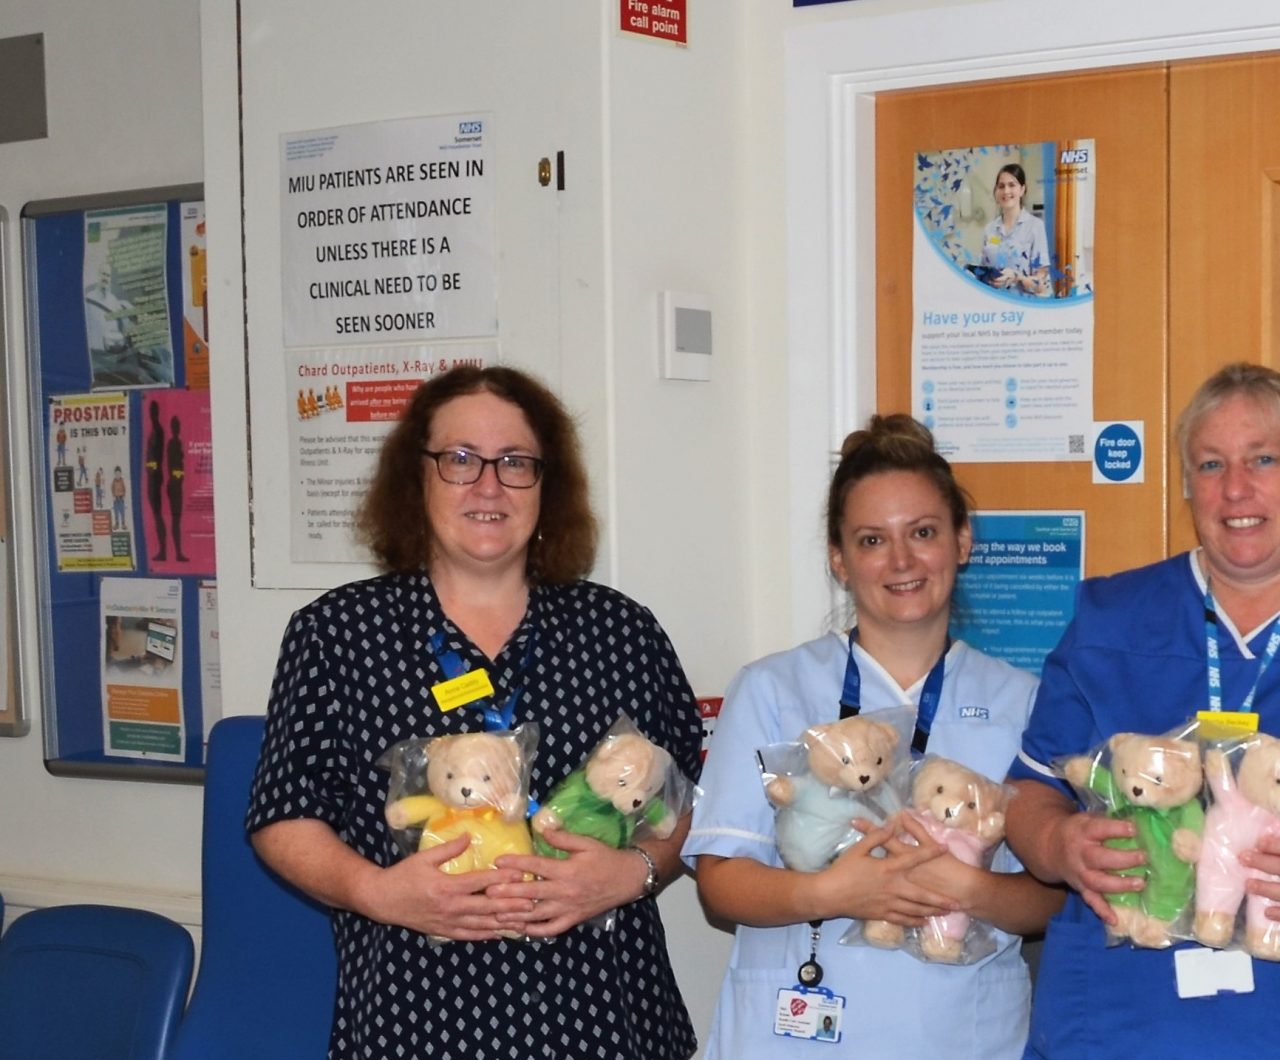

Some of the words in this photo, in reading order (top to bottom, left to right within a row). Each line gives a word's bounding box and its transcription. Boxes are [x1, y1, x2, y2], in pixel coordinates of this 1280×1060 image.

[628, 0, 648, 13] Fire
[652, 4, 680, 20] alarm
[630, 16, 649, 29] call
[652, 20, 679, 35] point
[459, 122, 482, 134] NHS
[1061, 150, 1088, 163] NHS
[288, 175, 315, 194] MIU
[319, 168, 381, 190] PATIENTS
[385, 164, 414, 183] ARE
[419, 161, 460, 180] SEEN
[465, 159, 484, 177] IN
[297, 208, 344, 229] ORDER
[347, 206, 366, 224] OF
[370, 197, 472, 221] ATTENDANCE
[315, 242, 368, 263] UNLESS
[372, 239, 417, 258] THERE
[421, 237, 435, 254] IS
[439, 236, 451, 254] A
[309, 279, 370, 299] CLINICAL
[374, 276, 412, 295] NEED
[417, 274, 437, 292] TO
[442, 272, 461, 290] BE
[336, 315, 370, 334] SEEN
[375, 312, 435, 332] SOONER
[923, 311, 958, 326] Have
[963, 311, 997, 327] your
[1001, 310, 1025, 326] say
[298, 363, 328, 377] Chard
[331, 362, 399, 377] Outpatients,
[403, 360, 434, 375] X-Ray
[438, 359, 447, 370] &
[54, 404, 126, 423] PROSTATE
[70, 428, 78, 438] IS
[81, 427, 99, 437] THIS
[102, 427, 118, 437] YOU
[121, 426, 127, 435] ?
[1100, 438, 1115, 447] Fire
[1117, 438, 1136, 447] door
[1108, 449, 1128, 459] keep
[1104, 460, 1131, 469] locked
[991, 542, 1005, 552] the
[1007, 543, 1025, 554] way
[1028, 544, 1041, 552] we
[1043, 542, 1067, 552] book
[969, 555, 983, 564] ent
[985, 555, 1048, 566] appointments
[1206, 636, 1219, 660] NHS
[1266, 633, 1280, 657] NHS
[1208, 666, 1220, 688] NHS
[1209, 695, 1221, 712] NH
[960, 707, 988, 719] NHS
